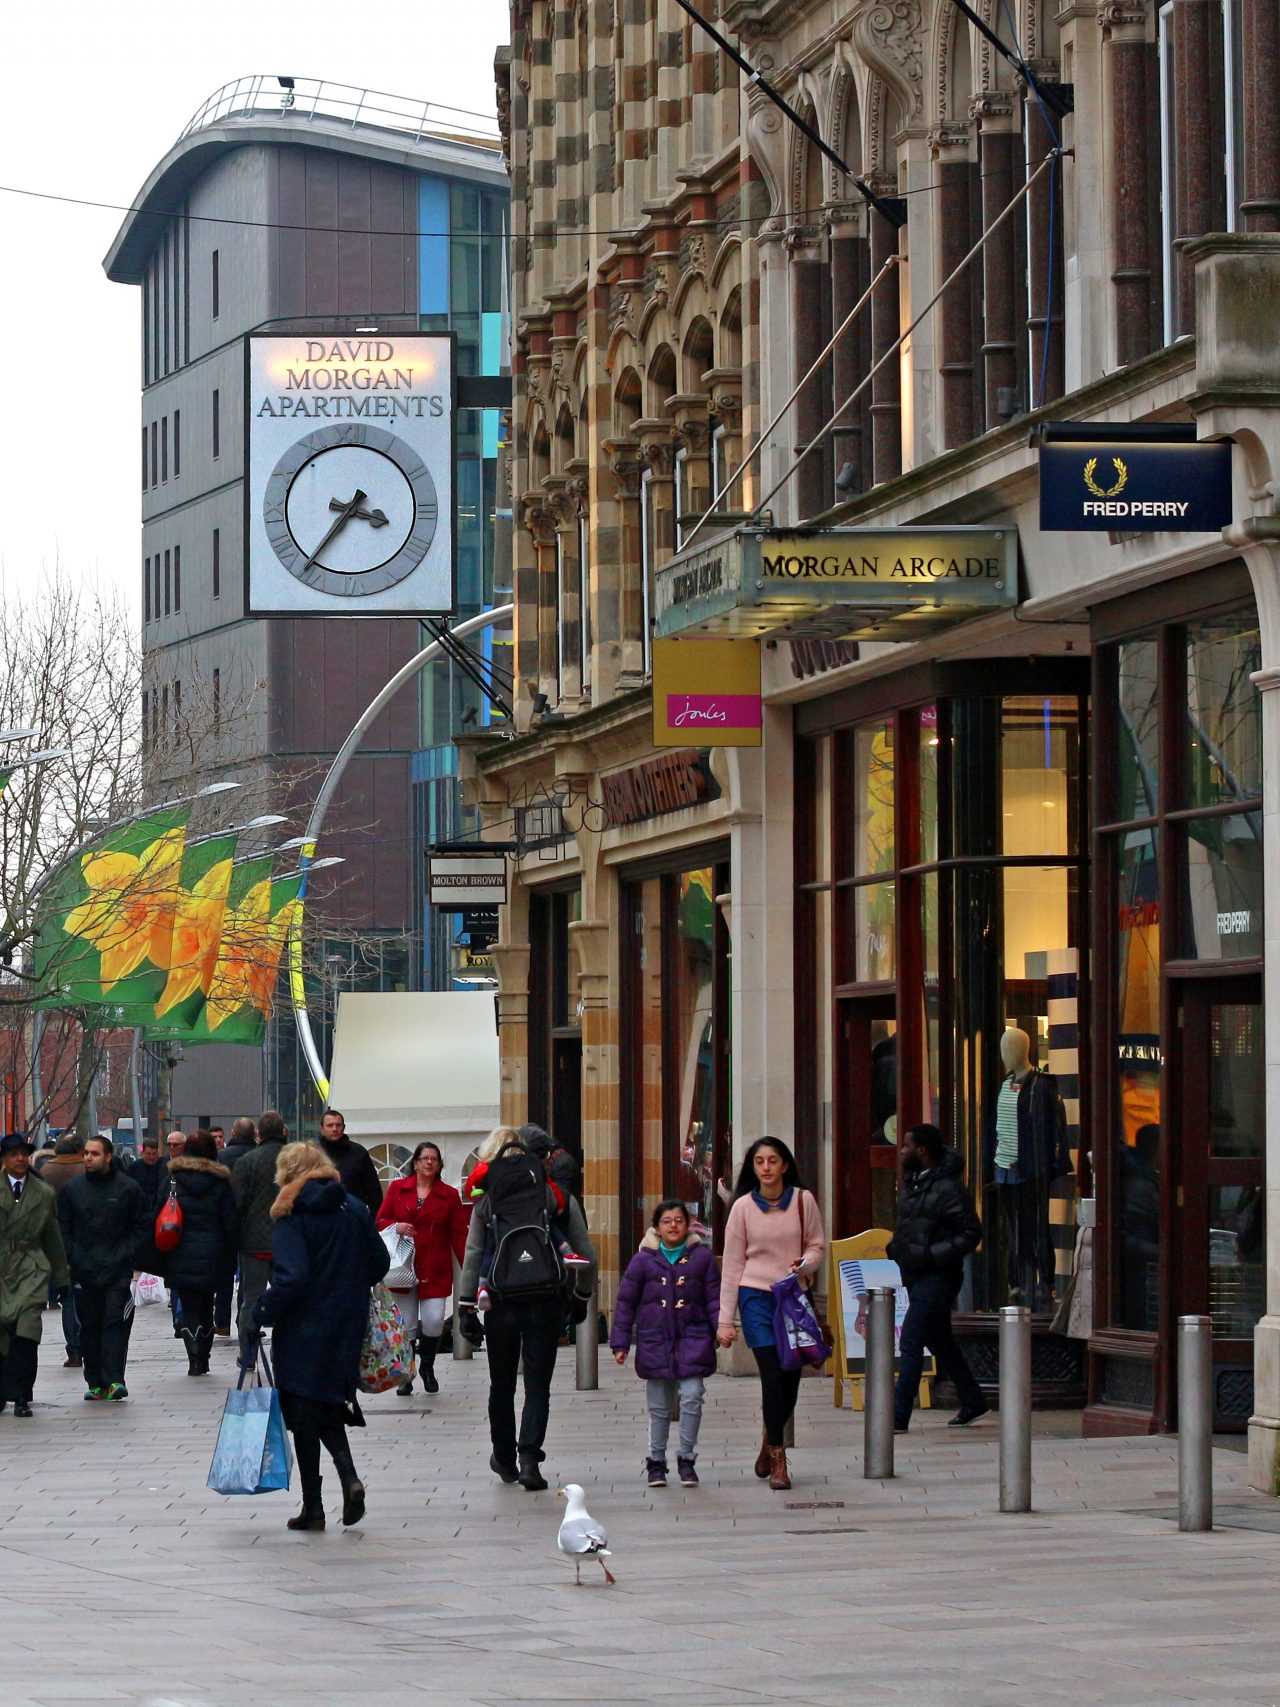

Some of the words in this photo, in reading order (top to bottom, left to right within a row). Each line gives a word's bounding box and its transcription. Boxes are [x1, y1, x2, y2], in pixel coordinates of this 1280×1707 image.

[305, 341, 394, 363] DAVID
[285, 368, 414, 390] MORGAN
[256, 395, 444, 418] APARTMENTS
[1083, 502, 1129, 516] FRED
[1131, 502, 1188, 517] PERRY
[761, 555, 879, 578] MORGAN
[890, 557, 1000, 578] ARCADE
[675, 695, 726, 726] joules
[433, 876, 468, 885] MOLTON
[471, 876, 503, 885] BROWN
[1217, 912, 1231, 935] FRED
[1231, 910, 1250, 933] PERRY
